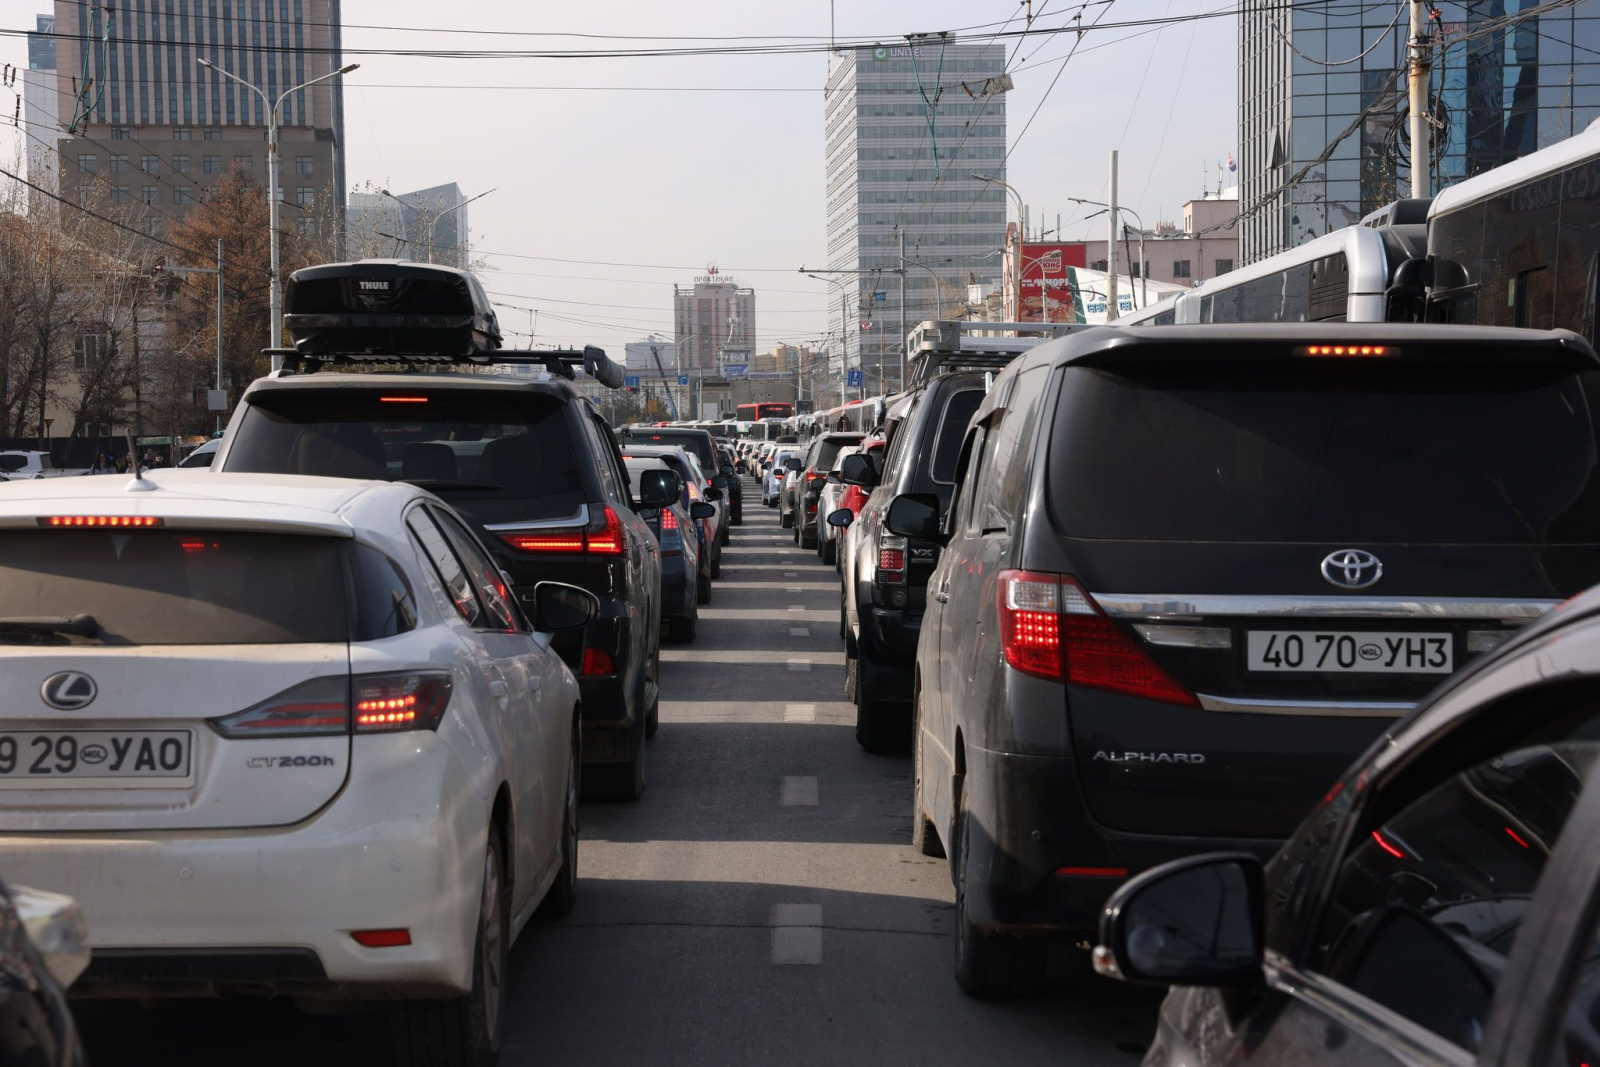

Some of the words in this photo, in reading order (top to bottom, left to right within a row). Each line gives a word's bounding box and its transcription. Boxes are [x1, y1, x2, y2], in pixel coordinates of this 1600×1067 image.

[890, 48, 925, 57] UNITEL
[359, 281, 389, 290] THULE
[911, 548, 933, 557] VX
[1263, 634, 1303, 668] 40
[1315, 634, 1356, 669] 70
[1362, 648, 1379, 657] MGL
[29, 735, 78, 774] 29
[1092, 750, 1206, 764] ALPHARD
